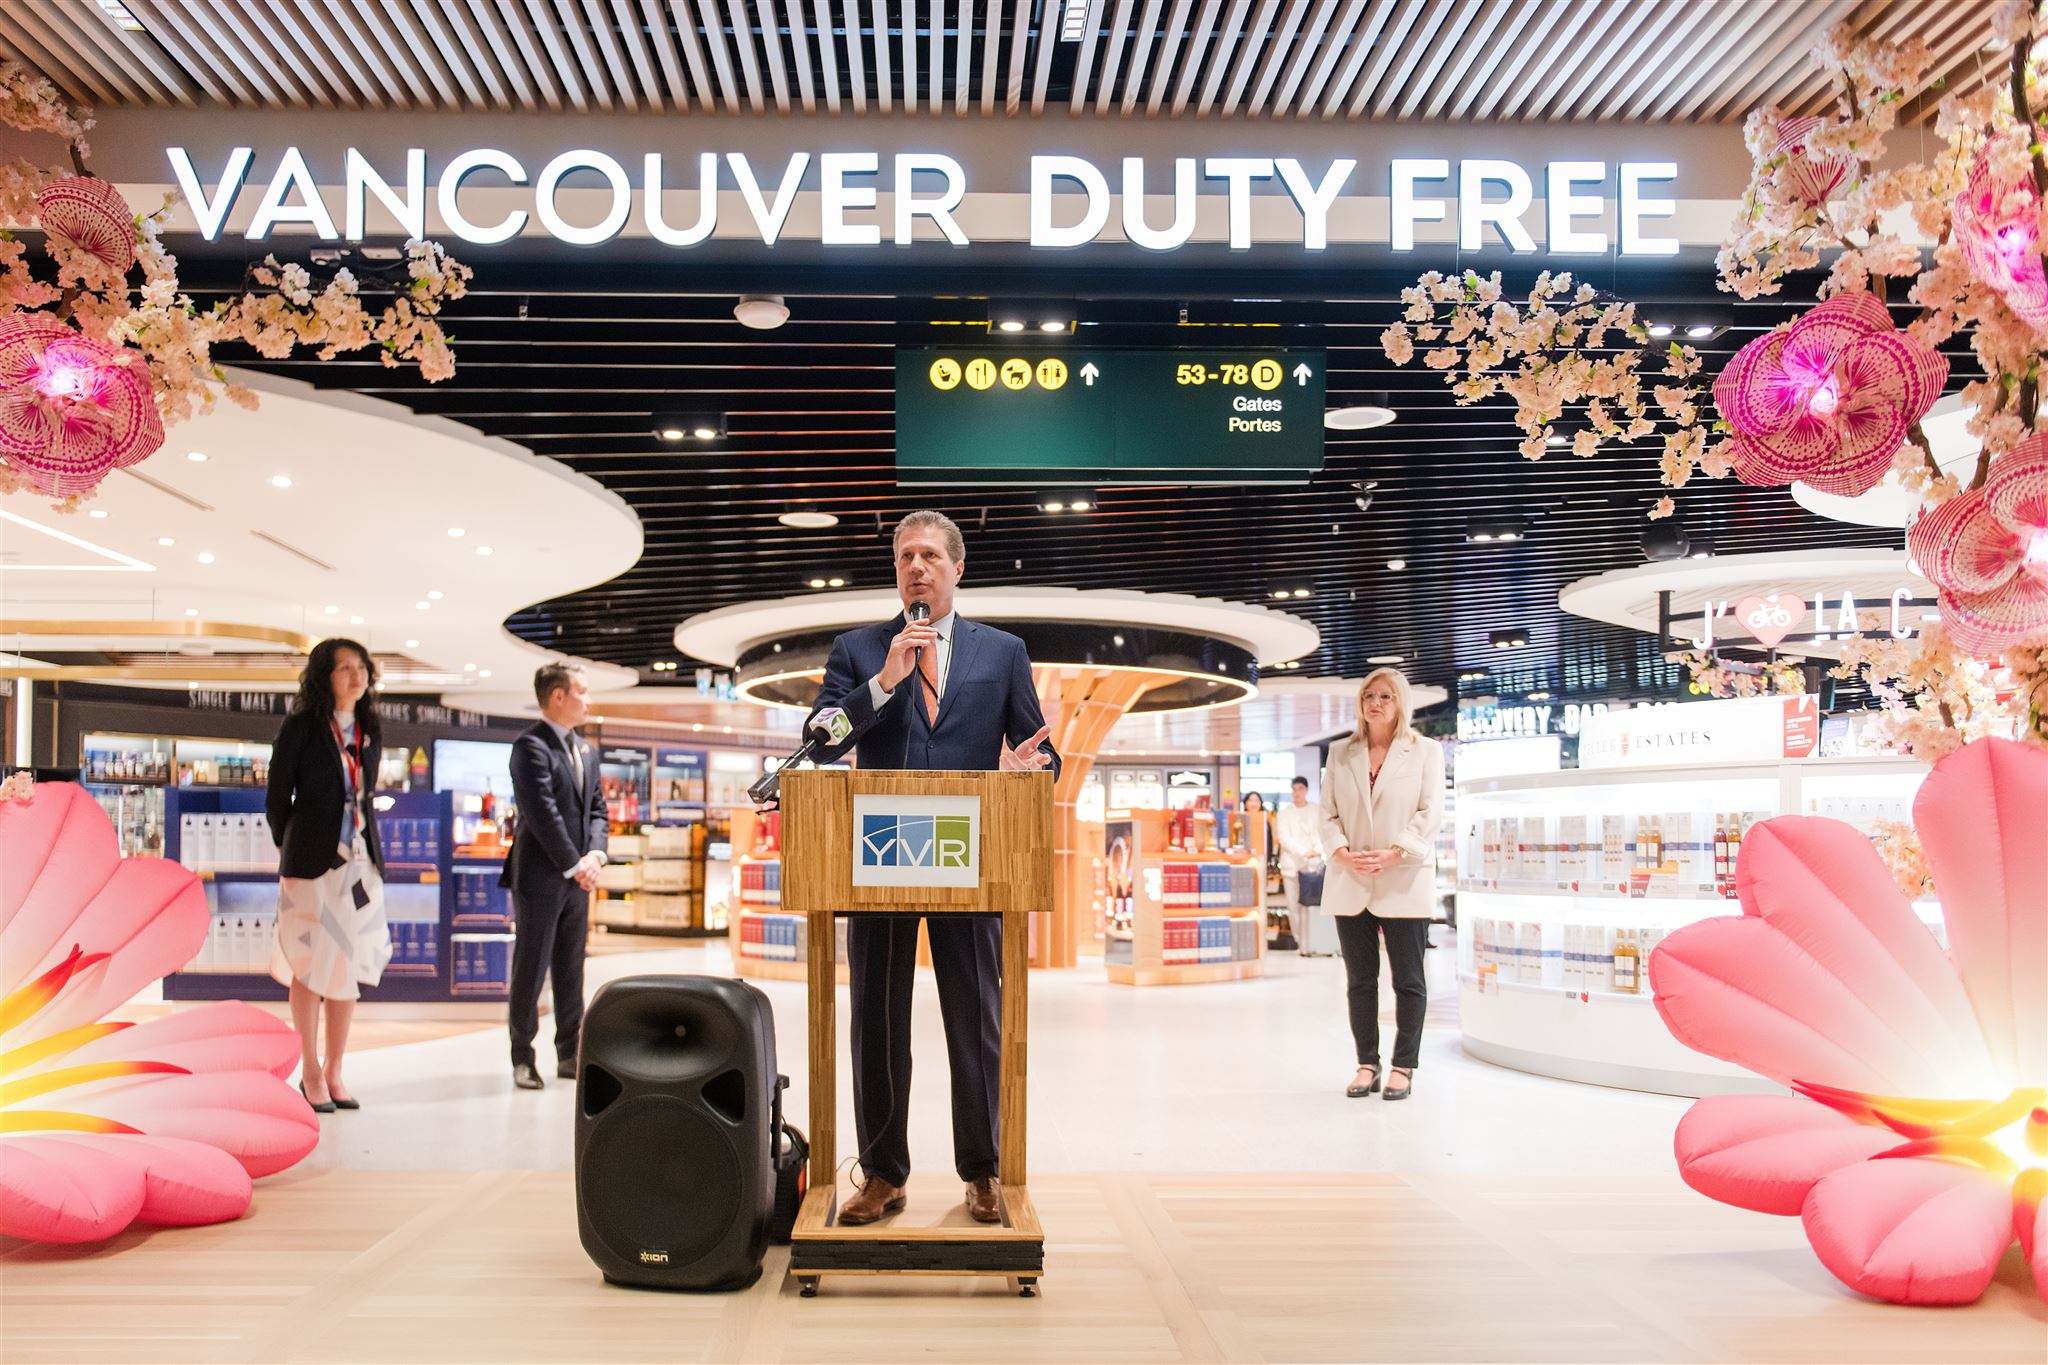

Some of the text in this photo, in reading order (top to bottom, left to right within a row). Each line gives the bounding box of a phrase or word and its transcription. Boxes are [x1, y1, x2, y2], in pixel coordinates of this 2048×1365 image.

[166, 146, 1680, 255] VANCOUVER DUTY FREE
[1176, 364, 1249, 385] 53-78
[1232, 395, 1282, 412] Gates
[1228, 417, 1282, 432] Portes
[1815, 591, 1859, 637] LA
[188, 690, 231, 711] SINGLE
[241, 692, 276, 714] MALT
[1635, 730, 1712, 749] ESTATES
[862, 836, 970, 867] YVR
